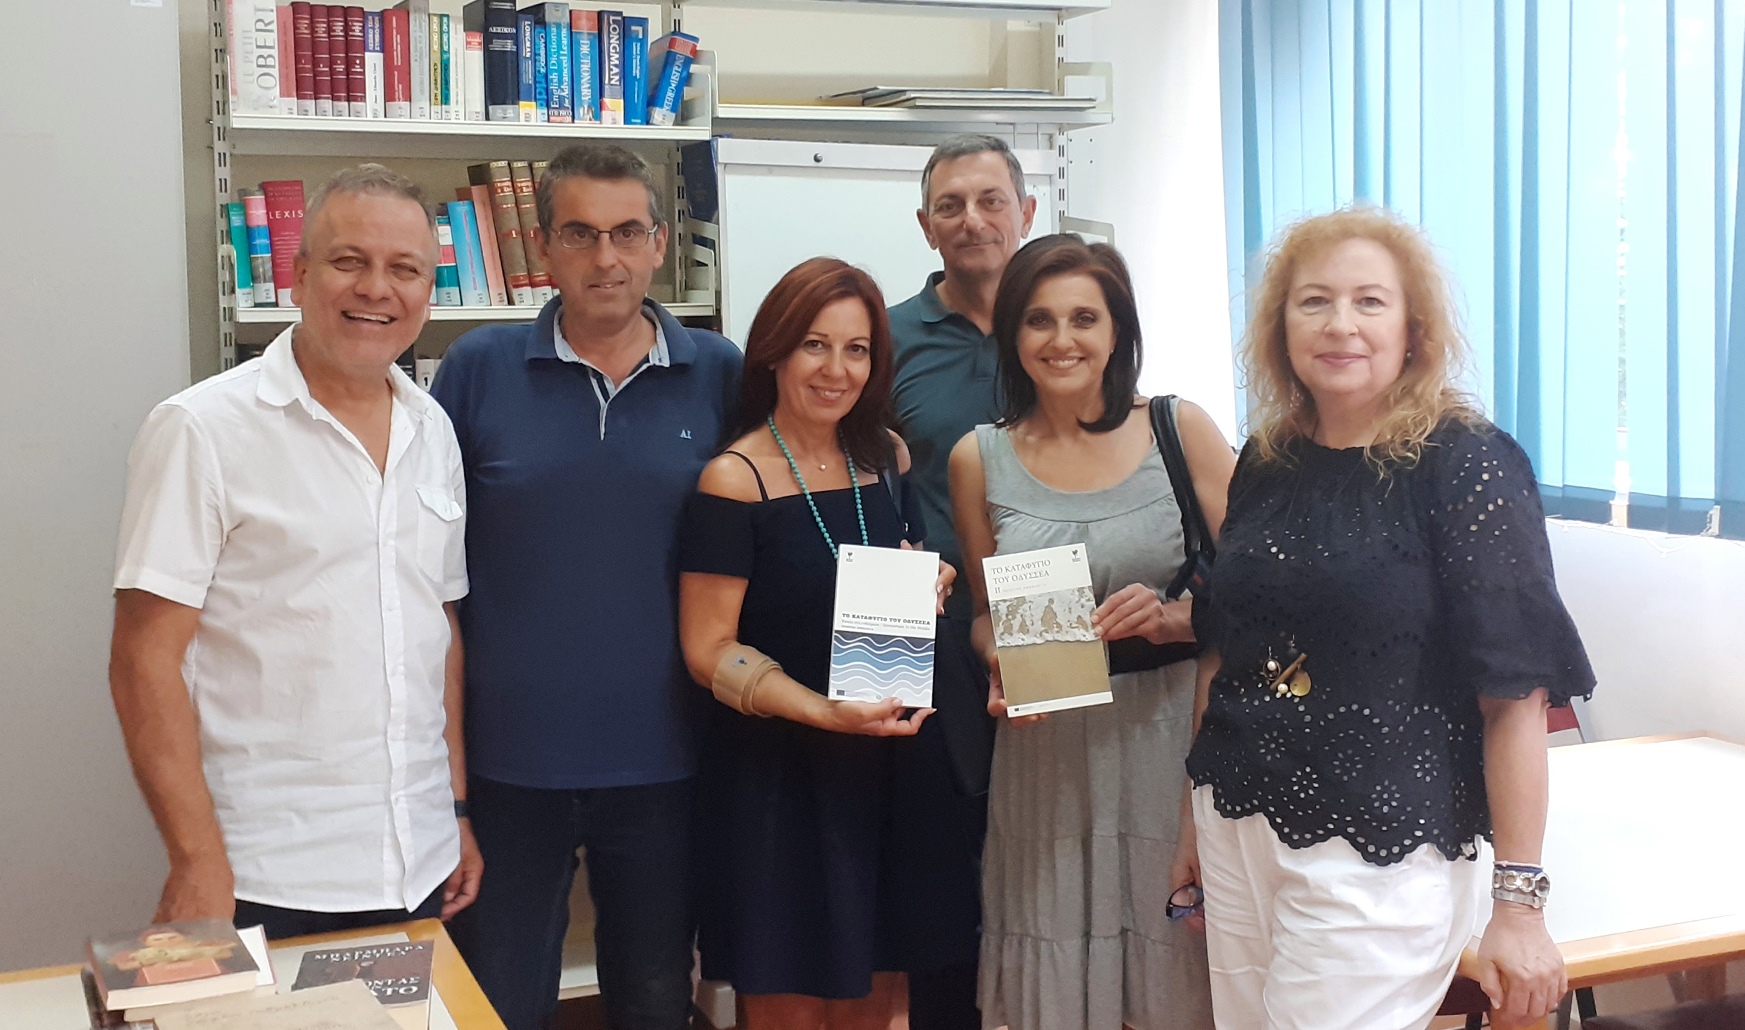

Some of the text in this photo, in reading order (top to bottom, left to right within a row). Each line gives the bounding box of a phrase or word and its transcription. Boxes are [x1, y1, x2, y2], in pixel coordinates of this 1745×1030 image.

[609, 15, 621, 86] LONGMAN
[560, 55, 569, 97] Advanced
[580, 39, 592, 101] DICTIONARY
[550, 72, 561, 108] English
[269, 209, 304, 220] LEXIS
[991, 559, 1051, 575] ΤΟ ΚΑΤΑΦΥΓΙΟ
[993, 570, 1050, 585] ΤΟΥ ΟΔΥΣΣΕΑ
[852, 614, 888, 622] ΚΑΤΑΦΥΓΙΟ
[903, 618, 931, 626] ΟΔΥΣΣΕΑ
